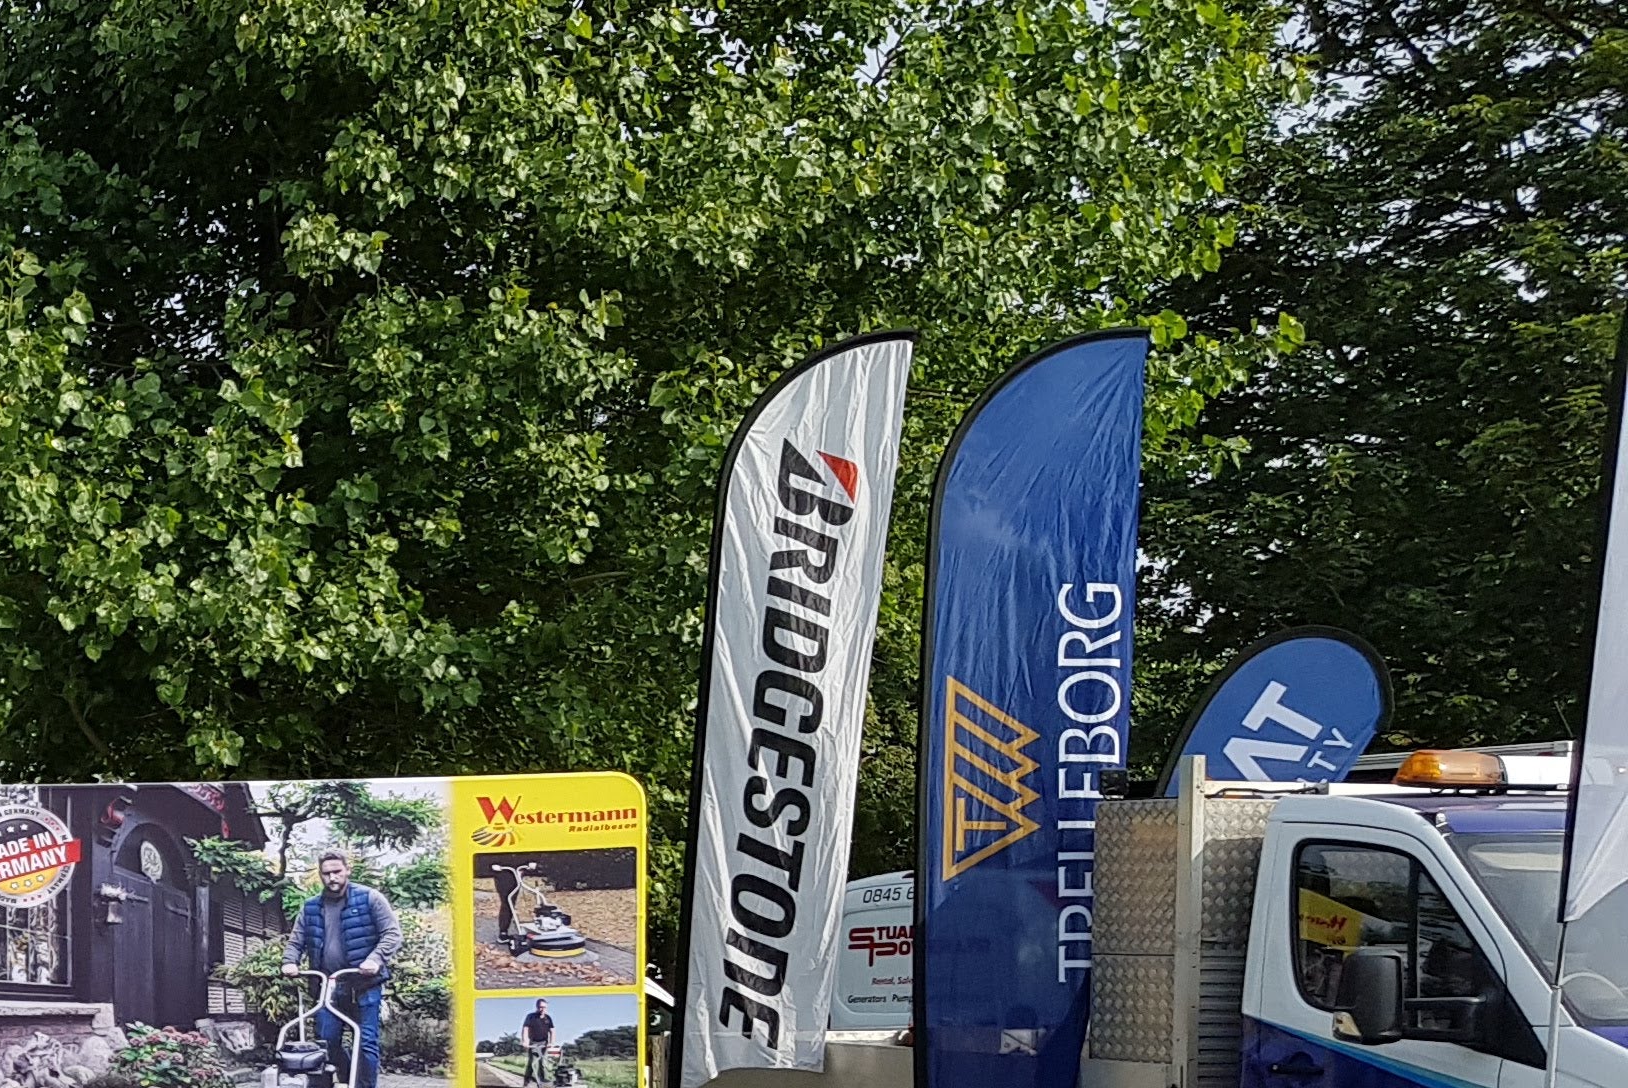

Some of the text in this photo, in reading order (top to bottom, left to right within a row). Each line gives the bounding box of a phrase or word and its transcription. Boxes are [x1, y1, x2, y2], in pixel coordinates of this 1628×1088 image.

[719, 437, 859, 1050] BRIDGESTONE
[476, 795, 637, 825] Westermann
[32, 831, 52, 849] IN
[863, 887, 903, 904] 0845
[848, 941, 914, 967] PO
